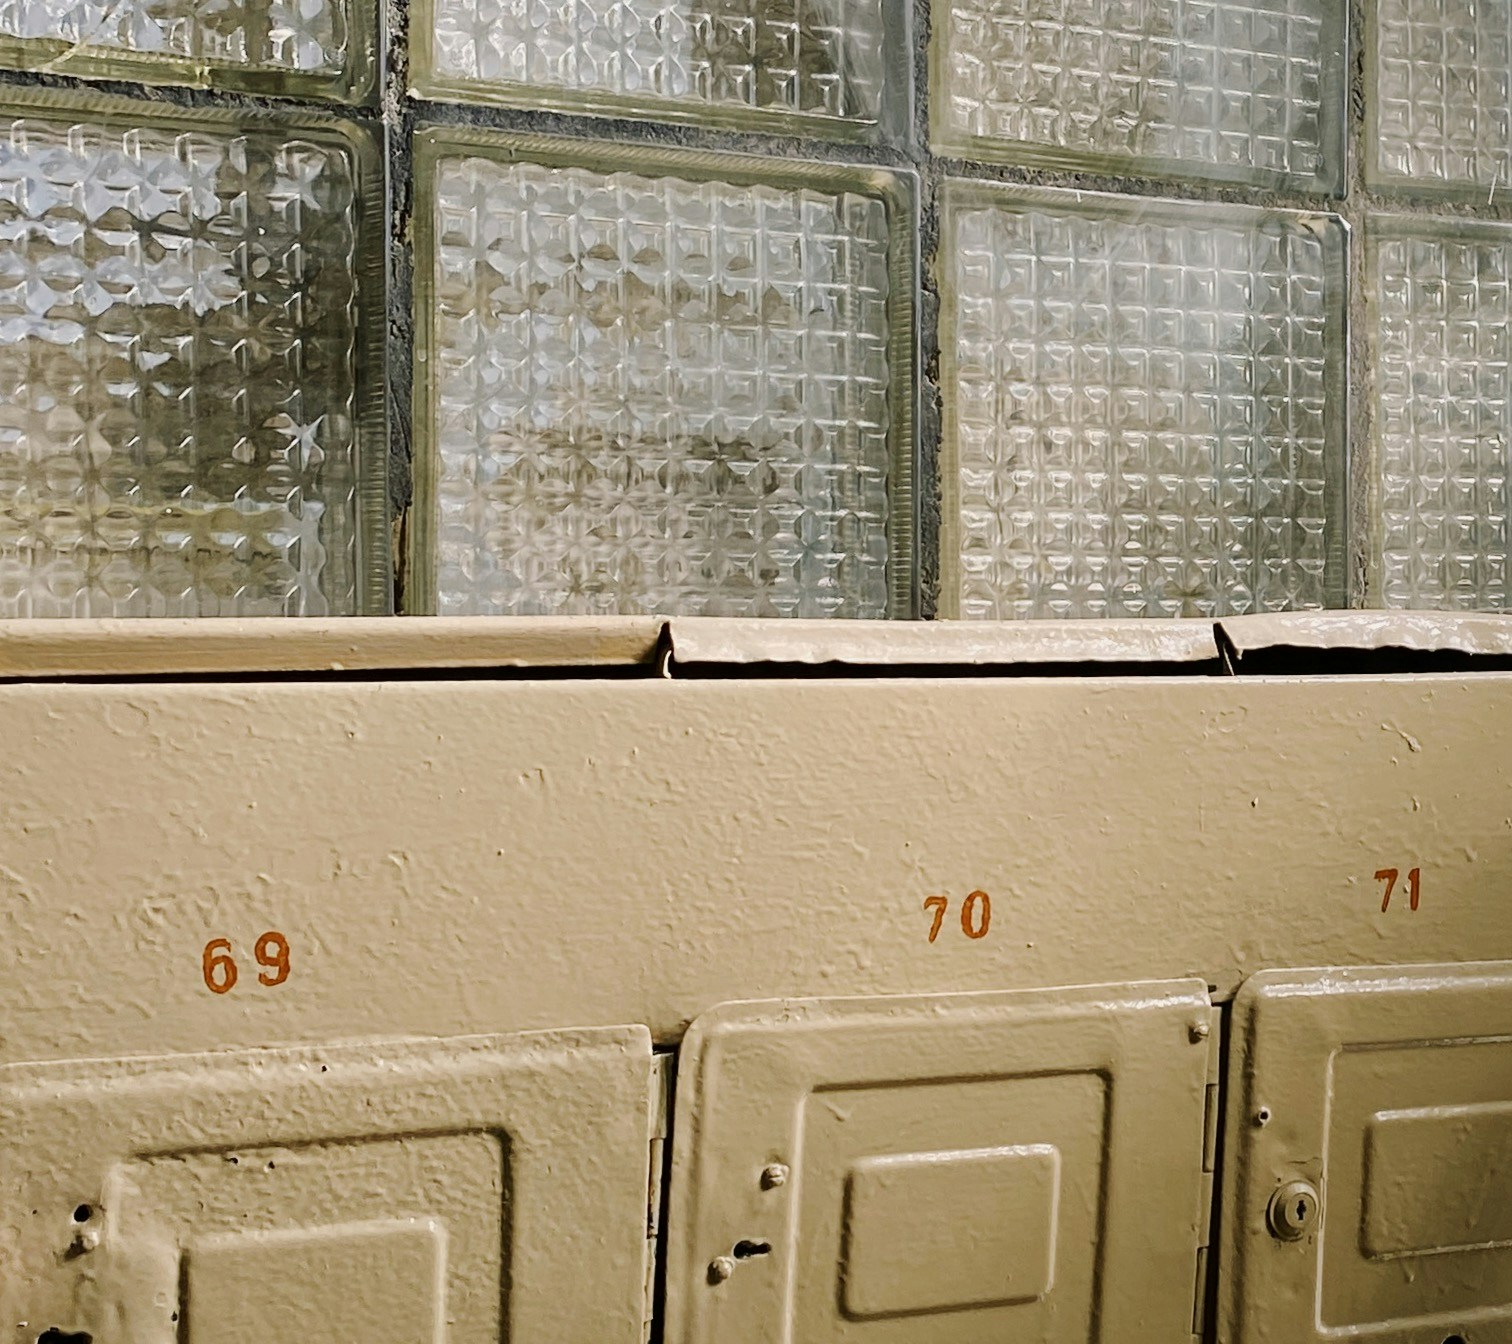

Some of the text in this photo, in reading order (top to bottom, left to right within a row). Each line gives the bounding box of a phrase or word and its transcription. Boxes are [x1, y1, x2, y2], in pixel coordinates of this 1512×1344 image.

[924, 890, 990, 943] 70
[1375, 868, 1420, 912] 71
[203, 932, 291, 994] 69
